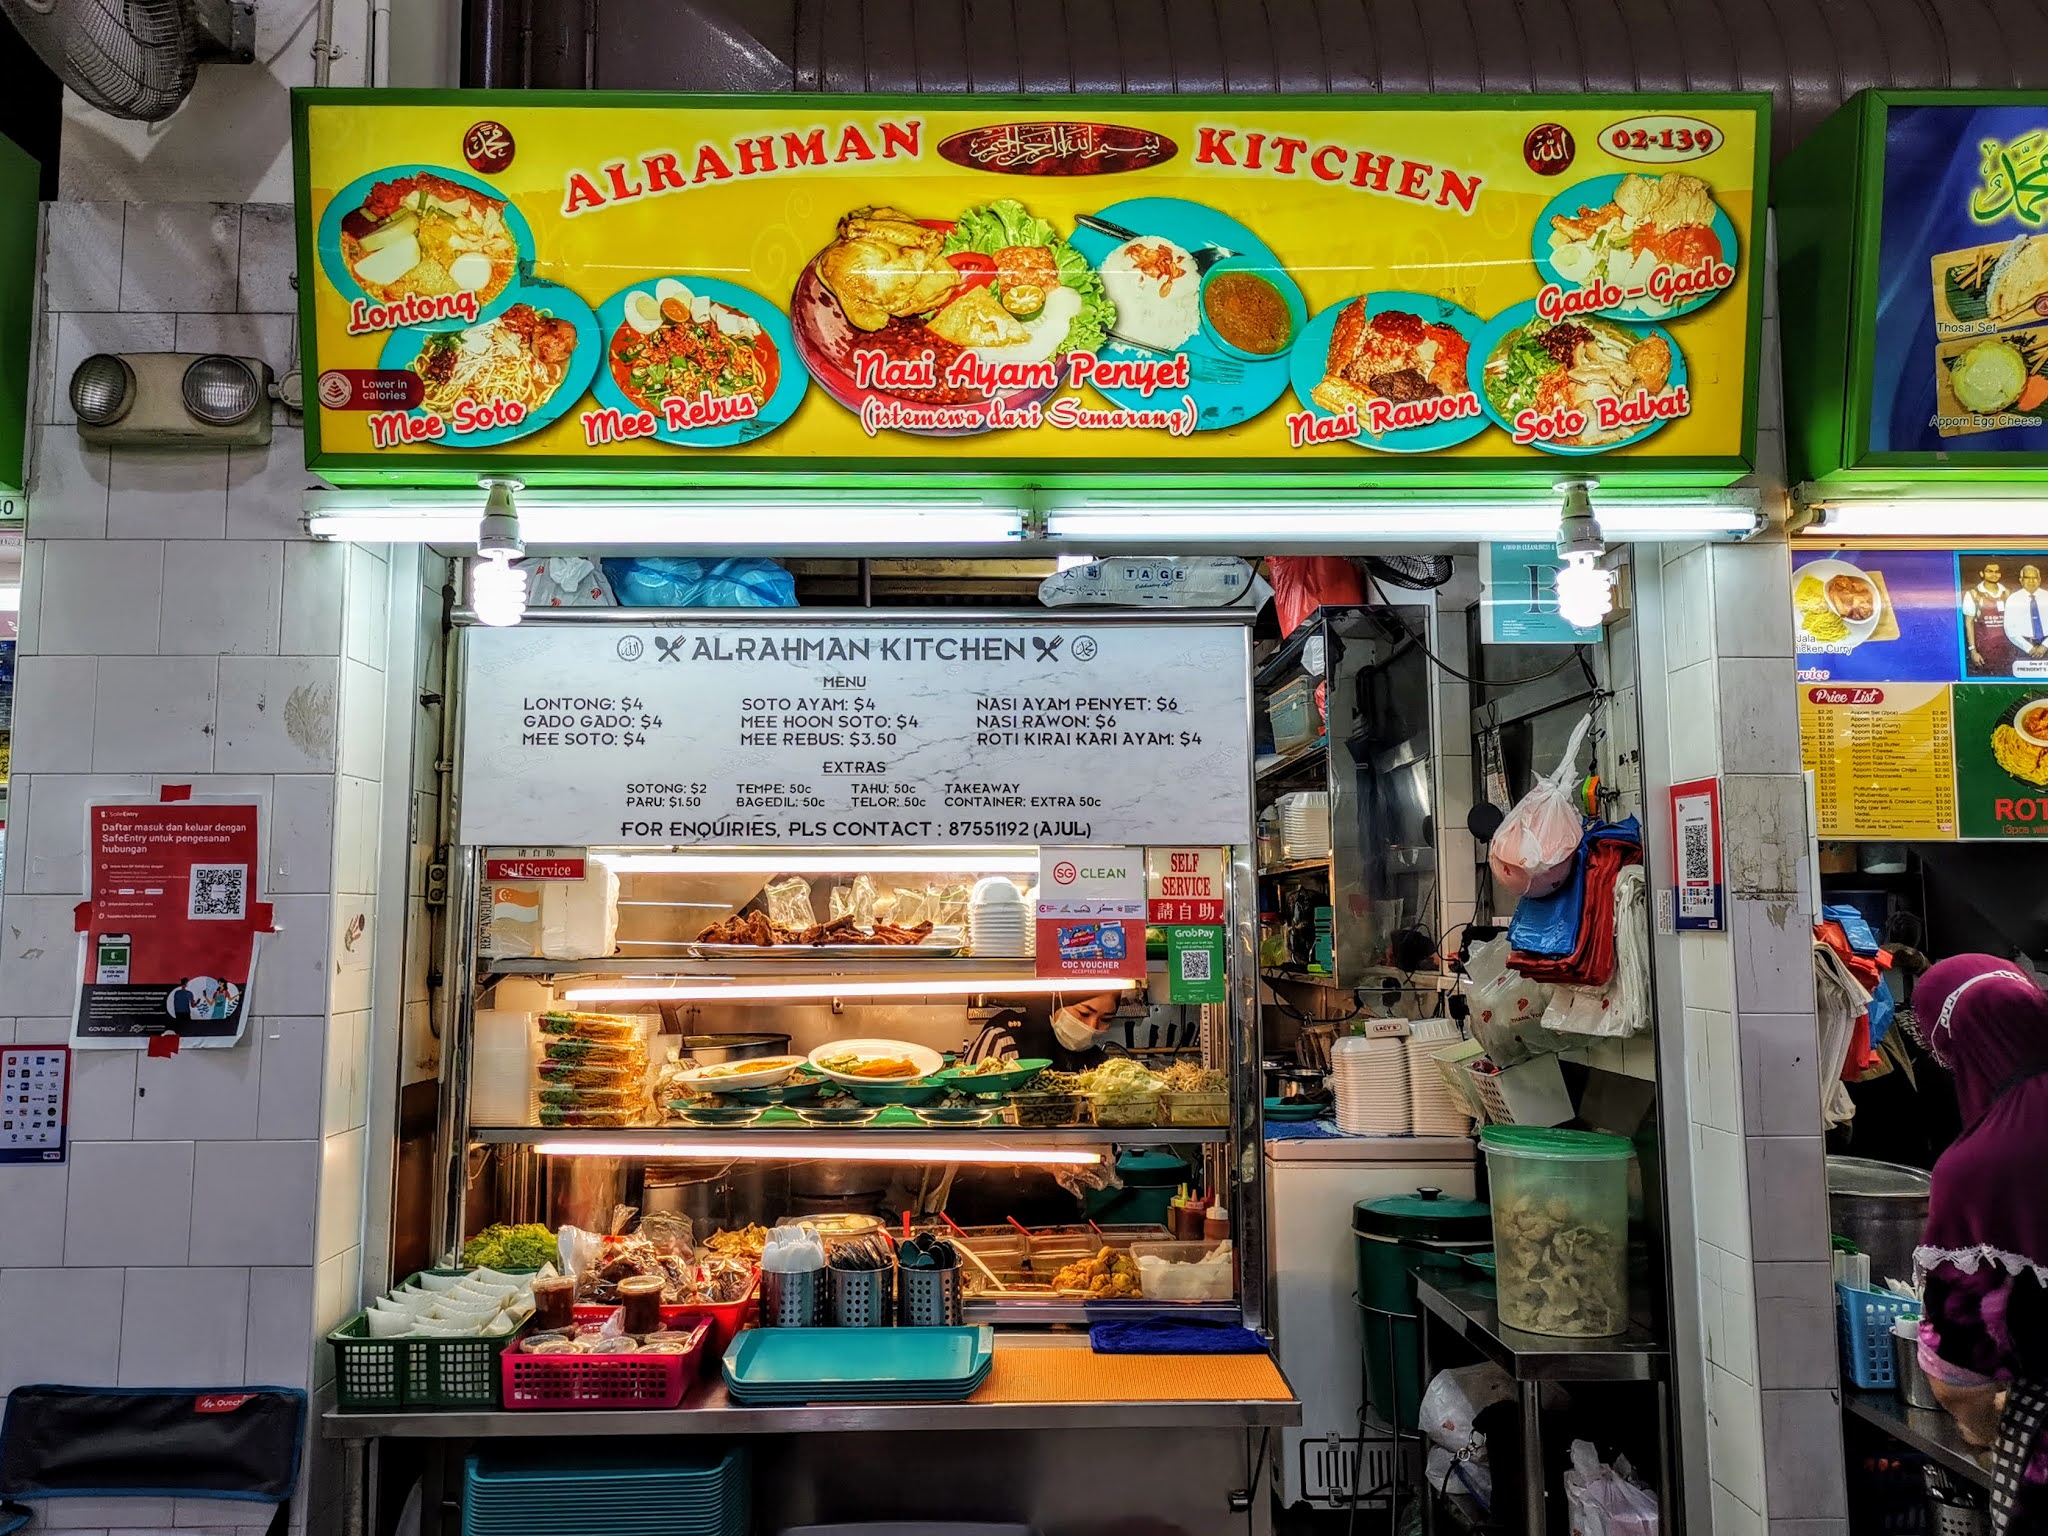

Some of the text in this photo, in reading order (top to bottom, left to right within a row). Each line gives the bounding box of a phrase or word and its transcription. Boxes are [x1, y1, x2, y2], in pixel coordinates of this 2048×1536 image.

[1611, 126, 1714, 152] 02-139
[564, 121, 924, 215] ALRAHMAN
[1197, 128, 1483, 213] KITCHEN
[351, 294, 476, 331] Lontong
[1937, 322, 1998, 333] Thosai Set
[856, 352, 1189, 396] Nasi Ayam Penyet
[362, 379, 407, 389] Lower in
[362, 390, 407, 400] calories
[583, 394, 755, 445] Mee Rebus
[861, 396, 1198, 435] (istemewa dari Semarang)
[1290, 392, 1480, 447] Nasi Rawon
[1514, 389, 1690, 443] Soto Babat
[372, 399, 526, 446] Mee Soto
[1929, 416, 2041, 430] Appom Egg Cheese
[0, 500, 14, 515] 0
[692, 637, 1026, 661] ALRAHMAN KITCHEN
[1826, 645, 1852, 655] Curry
[823, 676, 866, 688] MENU
[1816, 689, 1879, 703] Price List
[524, 698, 644, 711] LONTONG: $4
[742, 698, 876, 711] SOTO AYAM: $4
[977, 698, 1178, 711] NASI AYAM PENYET: $6
[523, 715, 663, 728] GADO GADO: $4
[741, 715, 918, 728] MEE HOON SOTO: $4
[977, 715, 1116, 728] NASI RAWON: $6
[522, 733, 646, 745] MEE SOTO: $4
[741, 733, 897, 746] MEE REBUS: $3.50
[977, 732, 1202, 746] ROTI KIRAI KARI AYAM: $4
[822, 761, 886, 774] EXTRAS
[626, 783, 707, 794] SOTONG: $2
[736, 783, 812, 794] TEMPE: 50c
[851, 783, 916, 794] TAHU: 50c
[945, 783, 1020, 794] TAKEAWAY
[626, 797, 701, 808] PARU: $1.50
[736, 797, 825, 808] BAGEDIL: 50c
[851, 797, 926, 808] TELOR: 50c
[944, 797, 1101, 808] CONTAINER: EXTRA 50c
[102, 823, 247, 833] Daftar masuk dan keluar dengan
[621, 821, 1091, 838] FOR ENQUIRIES, PLS CONTACT 87551192 (AJUL)
[102, 834, 230, 844] SafeEntry untuk pengesanan
[102, 845, 147, 855] hubungan
[499, 863, 571, 876] Self Service
[1170, 853, 1199, 873] SELF
[1056, 868, 1126, 879] SG CLEAN
[1162, 877, 1211, 896] SERVICE
[480, 885, 493, 949] RECTANGULAR
[1157, 902, 1215, 921] 請自助
[1174, 929, 1215, 939] GrabPay
[1062, 961, 1120, 969] CDC VOUCHER
[1510, 1015, 1530, 1024] THANK
